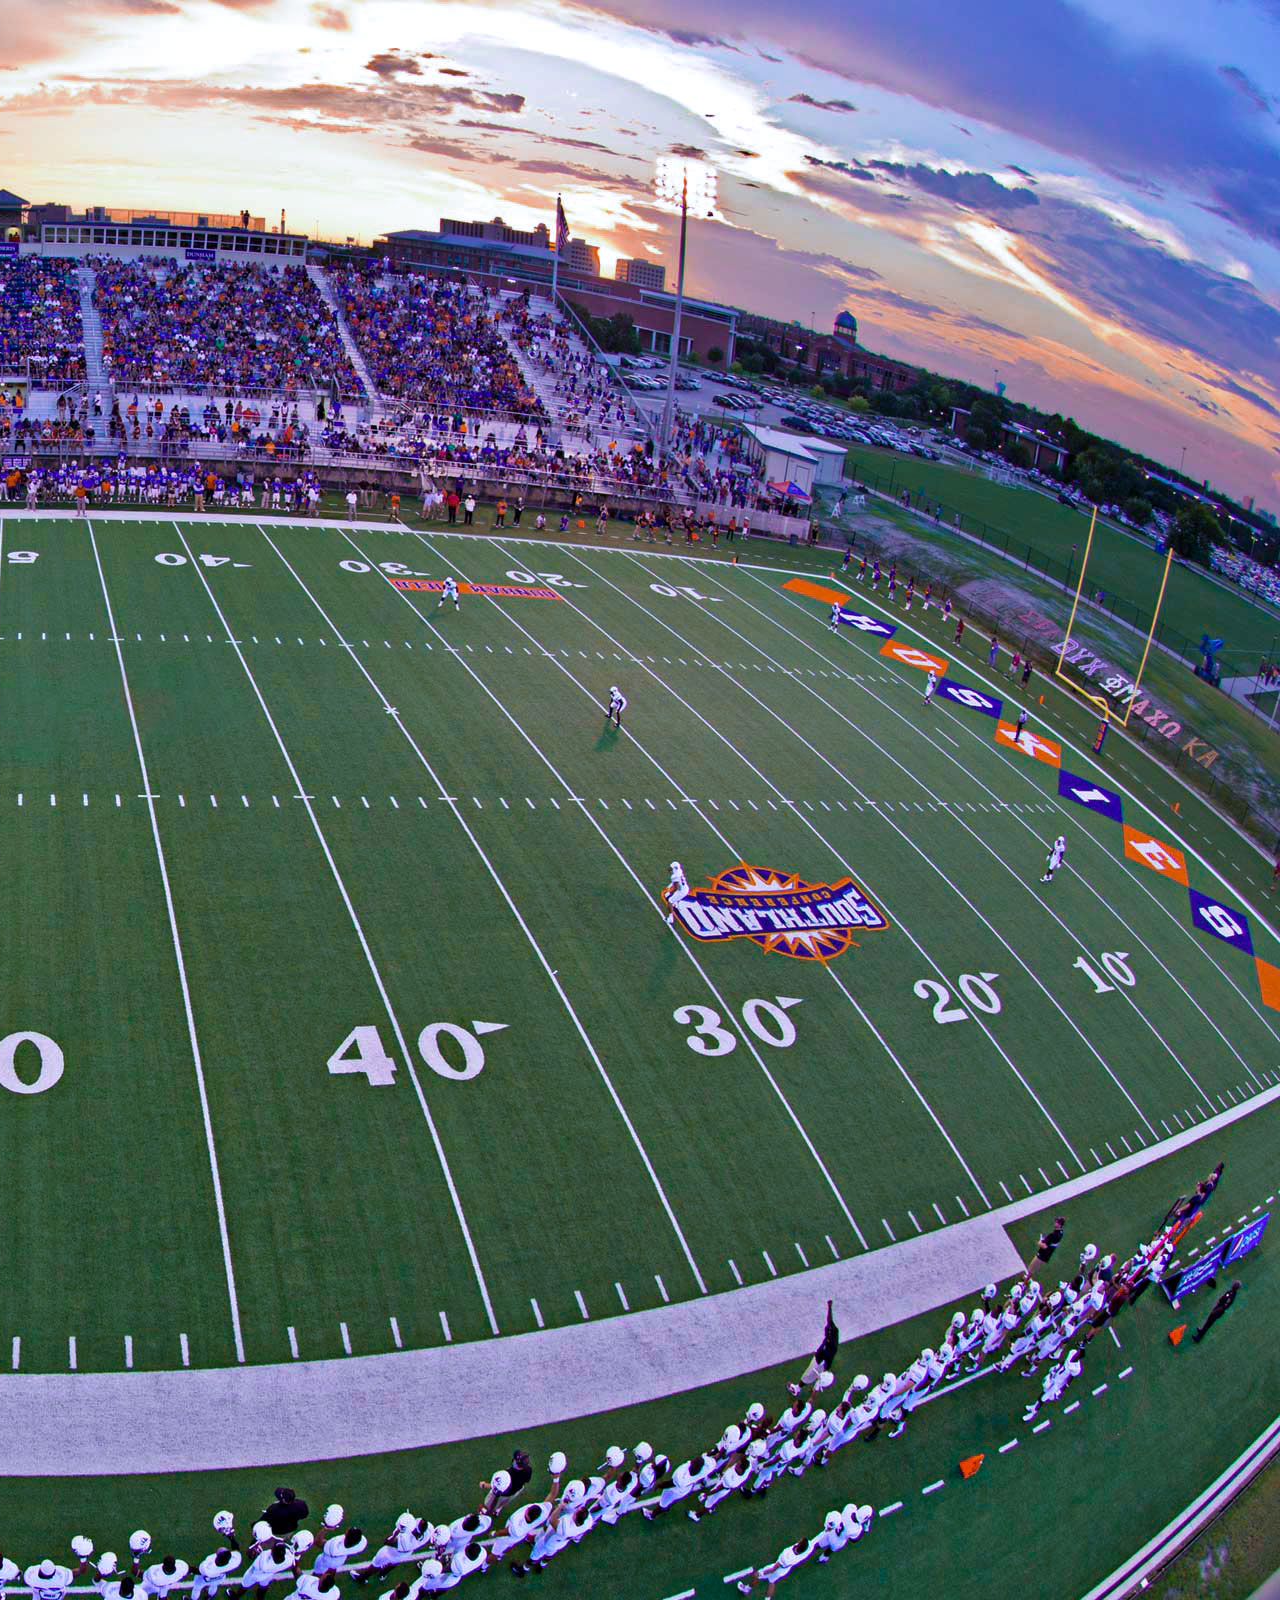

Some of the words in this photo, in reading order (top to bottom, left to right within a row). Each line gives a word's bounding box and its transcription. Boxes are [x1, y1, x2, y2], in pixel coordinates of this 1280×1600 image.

[154, 552, 231, 567] 40
[339, 559, 413, 576] 30
[505, 570, 577, 588] 20
[649, 582, 709, 600] 10
[675, 887, 882, 937] SOUTHLAND
[706, 890, 831, 907] CONFERENCE
[1072, 953, 1136, 994] 10
[913, 974, 1001, 1024] 20
[673, 998, 796, 1056] 30
[327, 1022, 485, 1086] 40
